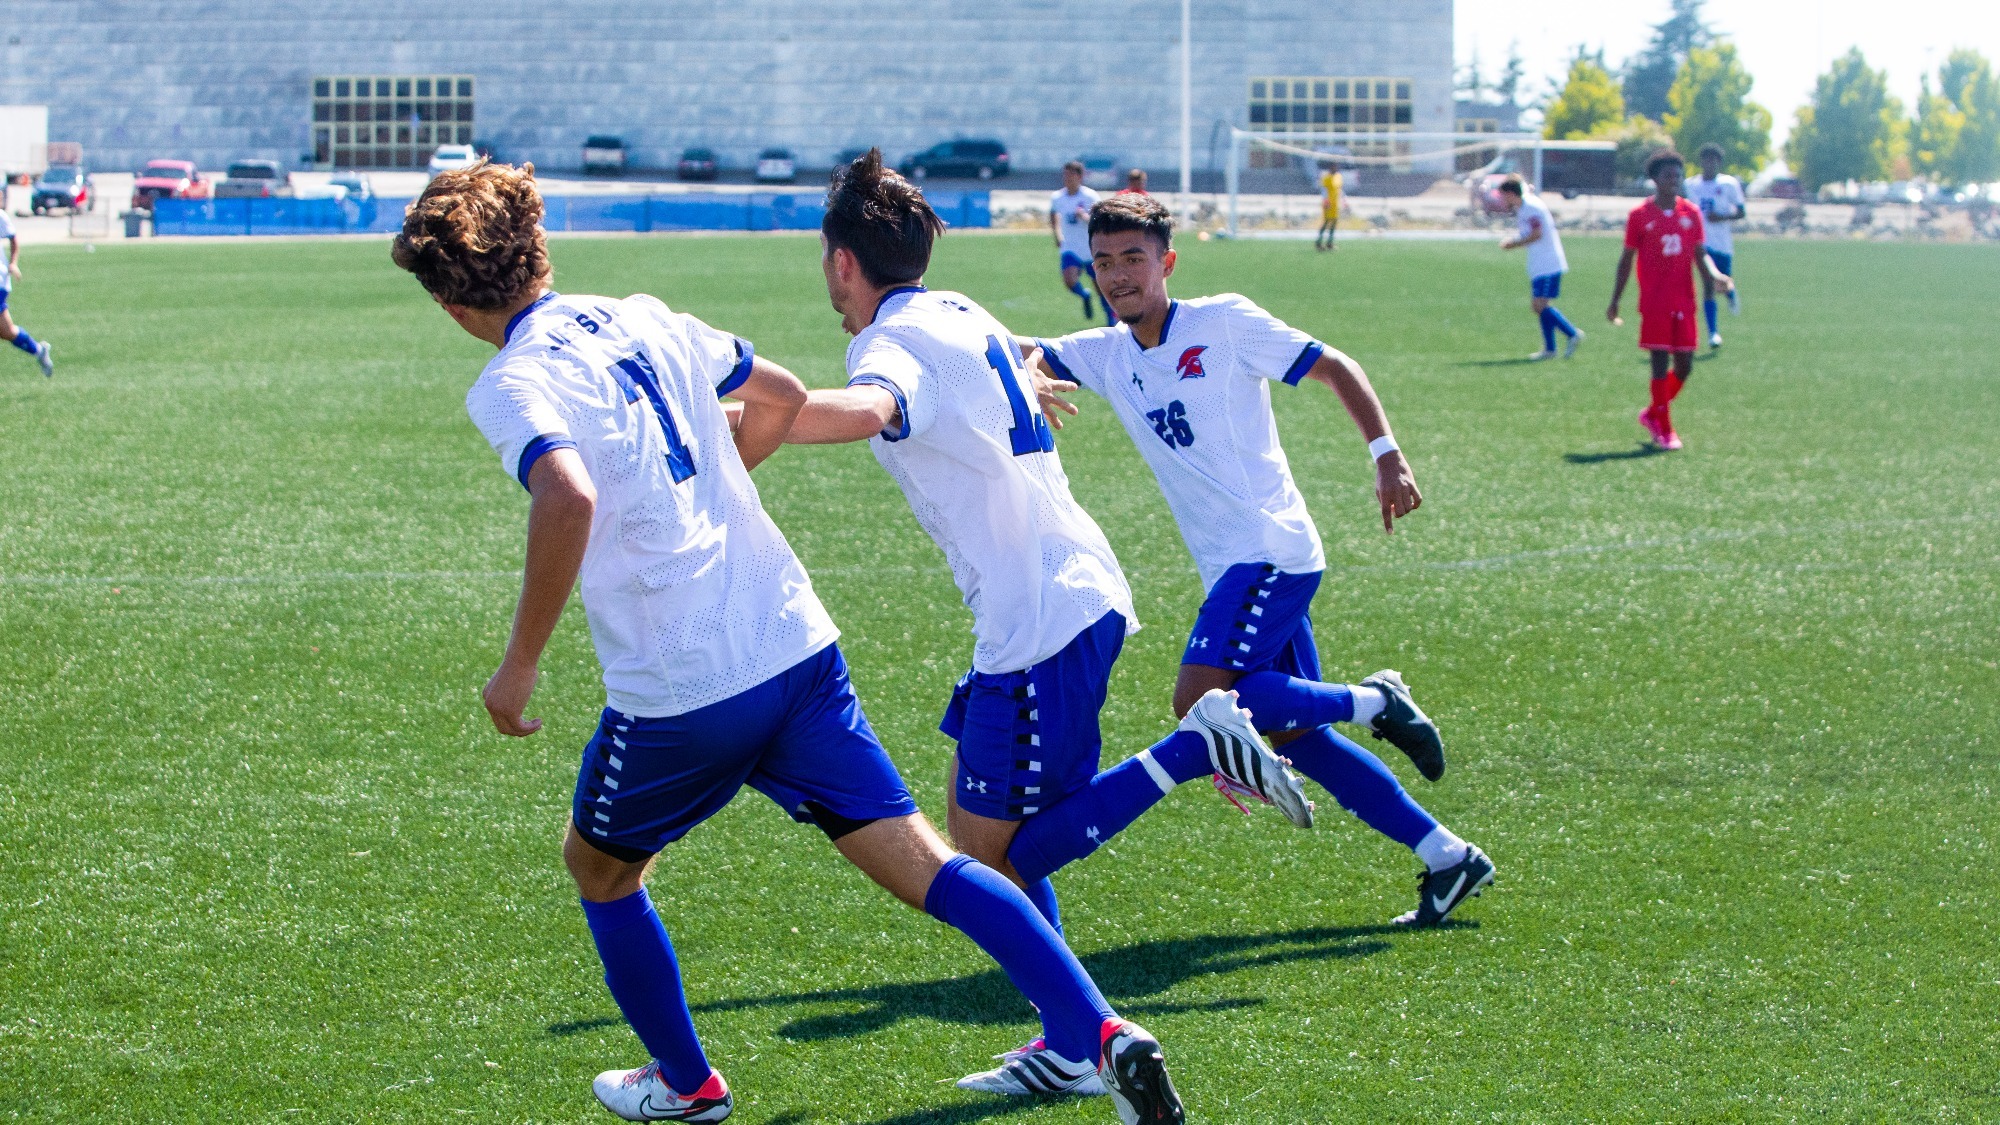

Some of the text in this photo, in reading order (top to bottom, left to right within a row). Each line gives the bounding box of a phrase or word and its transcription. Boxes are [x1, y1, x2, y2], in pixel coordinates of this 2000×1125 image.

[1661, 233, 1682, 257] 23
[606, 351, 697, 485] 7
[1146, 399, 1195, 450] 26
